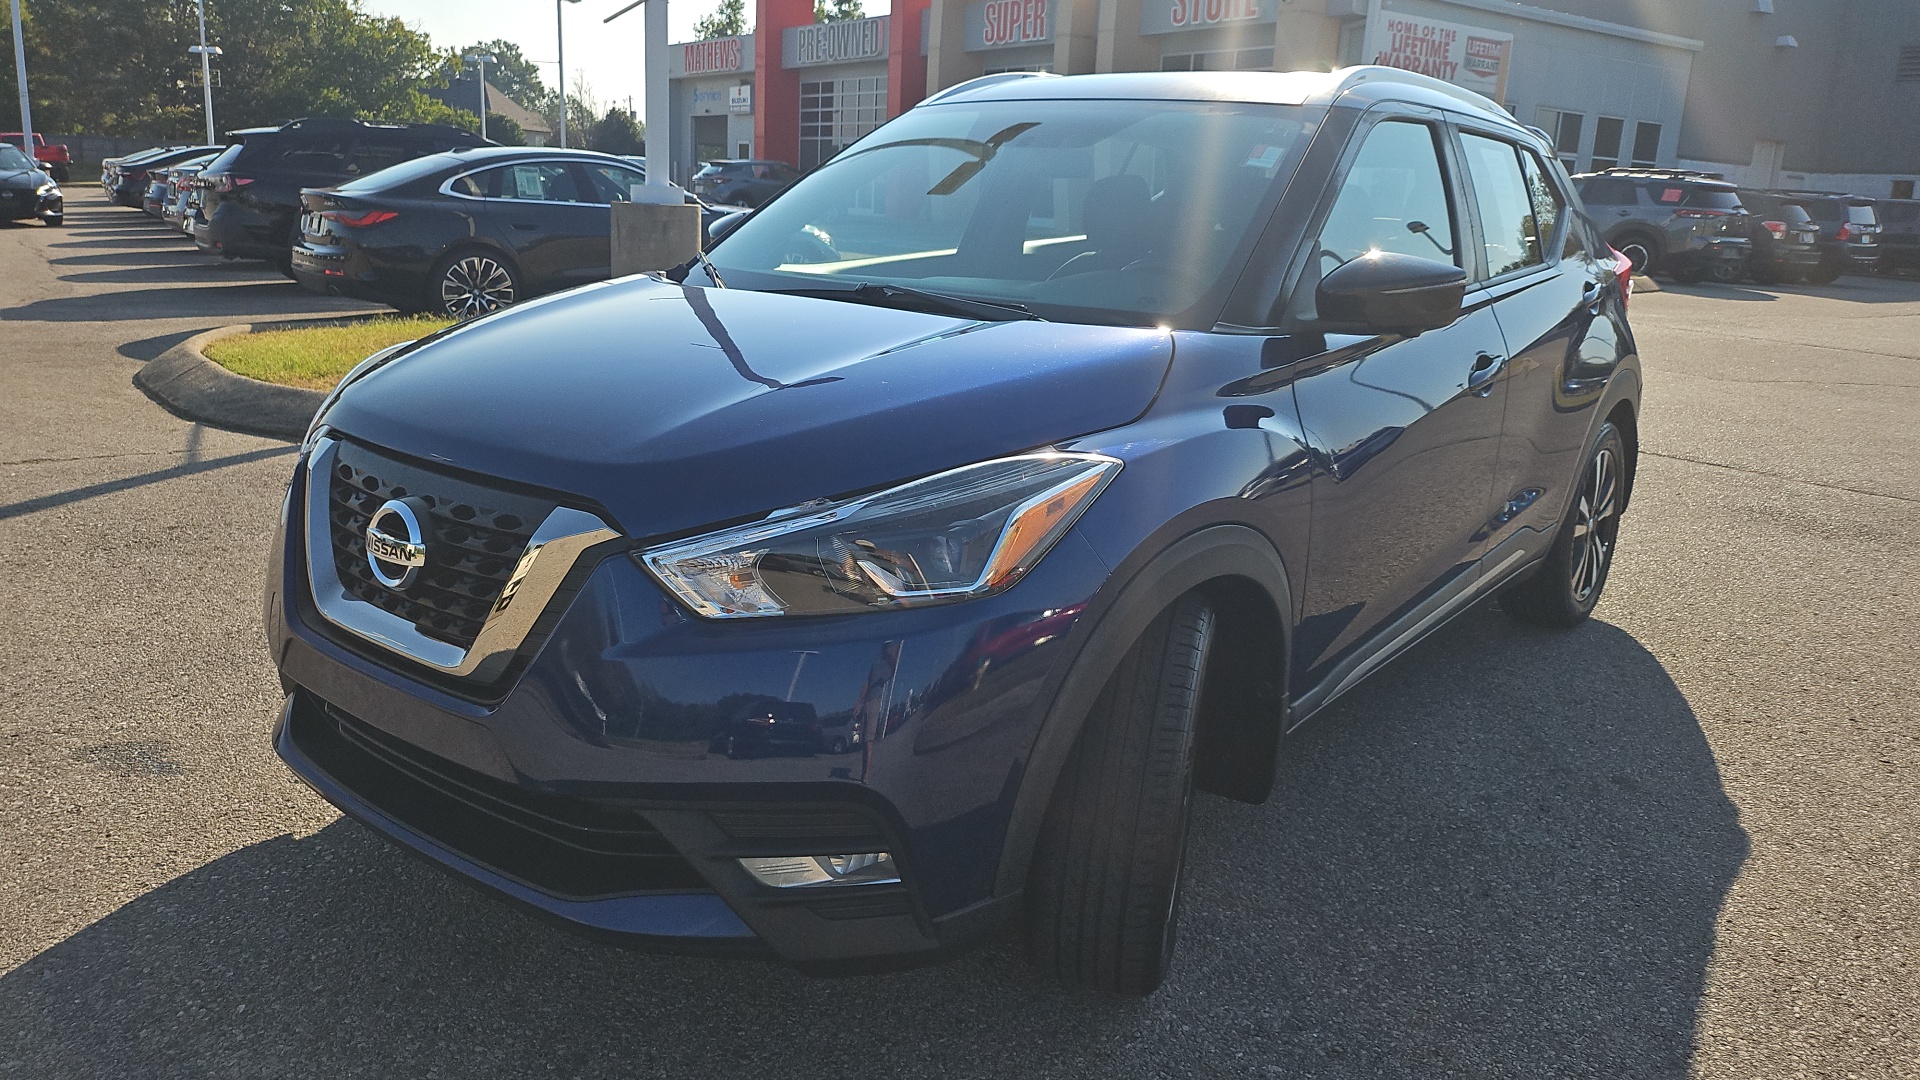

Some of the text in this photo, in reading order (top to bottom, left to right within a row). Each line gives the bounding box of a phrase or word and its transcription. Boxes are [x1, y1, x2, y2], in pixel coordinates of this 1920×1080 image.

[984, 0, 1046, 45] SUPER
[1388, 19, 1457, 42] HOME OF THE
[685, 38, 739, 73] MATHEWS
[798, 19, 880, 64] PRE-OWNED
[1391, 32, 1450, 60] LIFETIME
[1468, 39, 1502, 57] LIFETIM
[1378, 50, 1458, 80] WARRANTY
